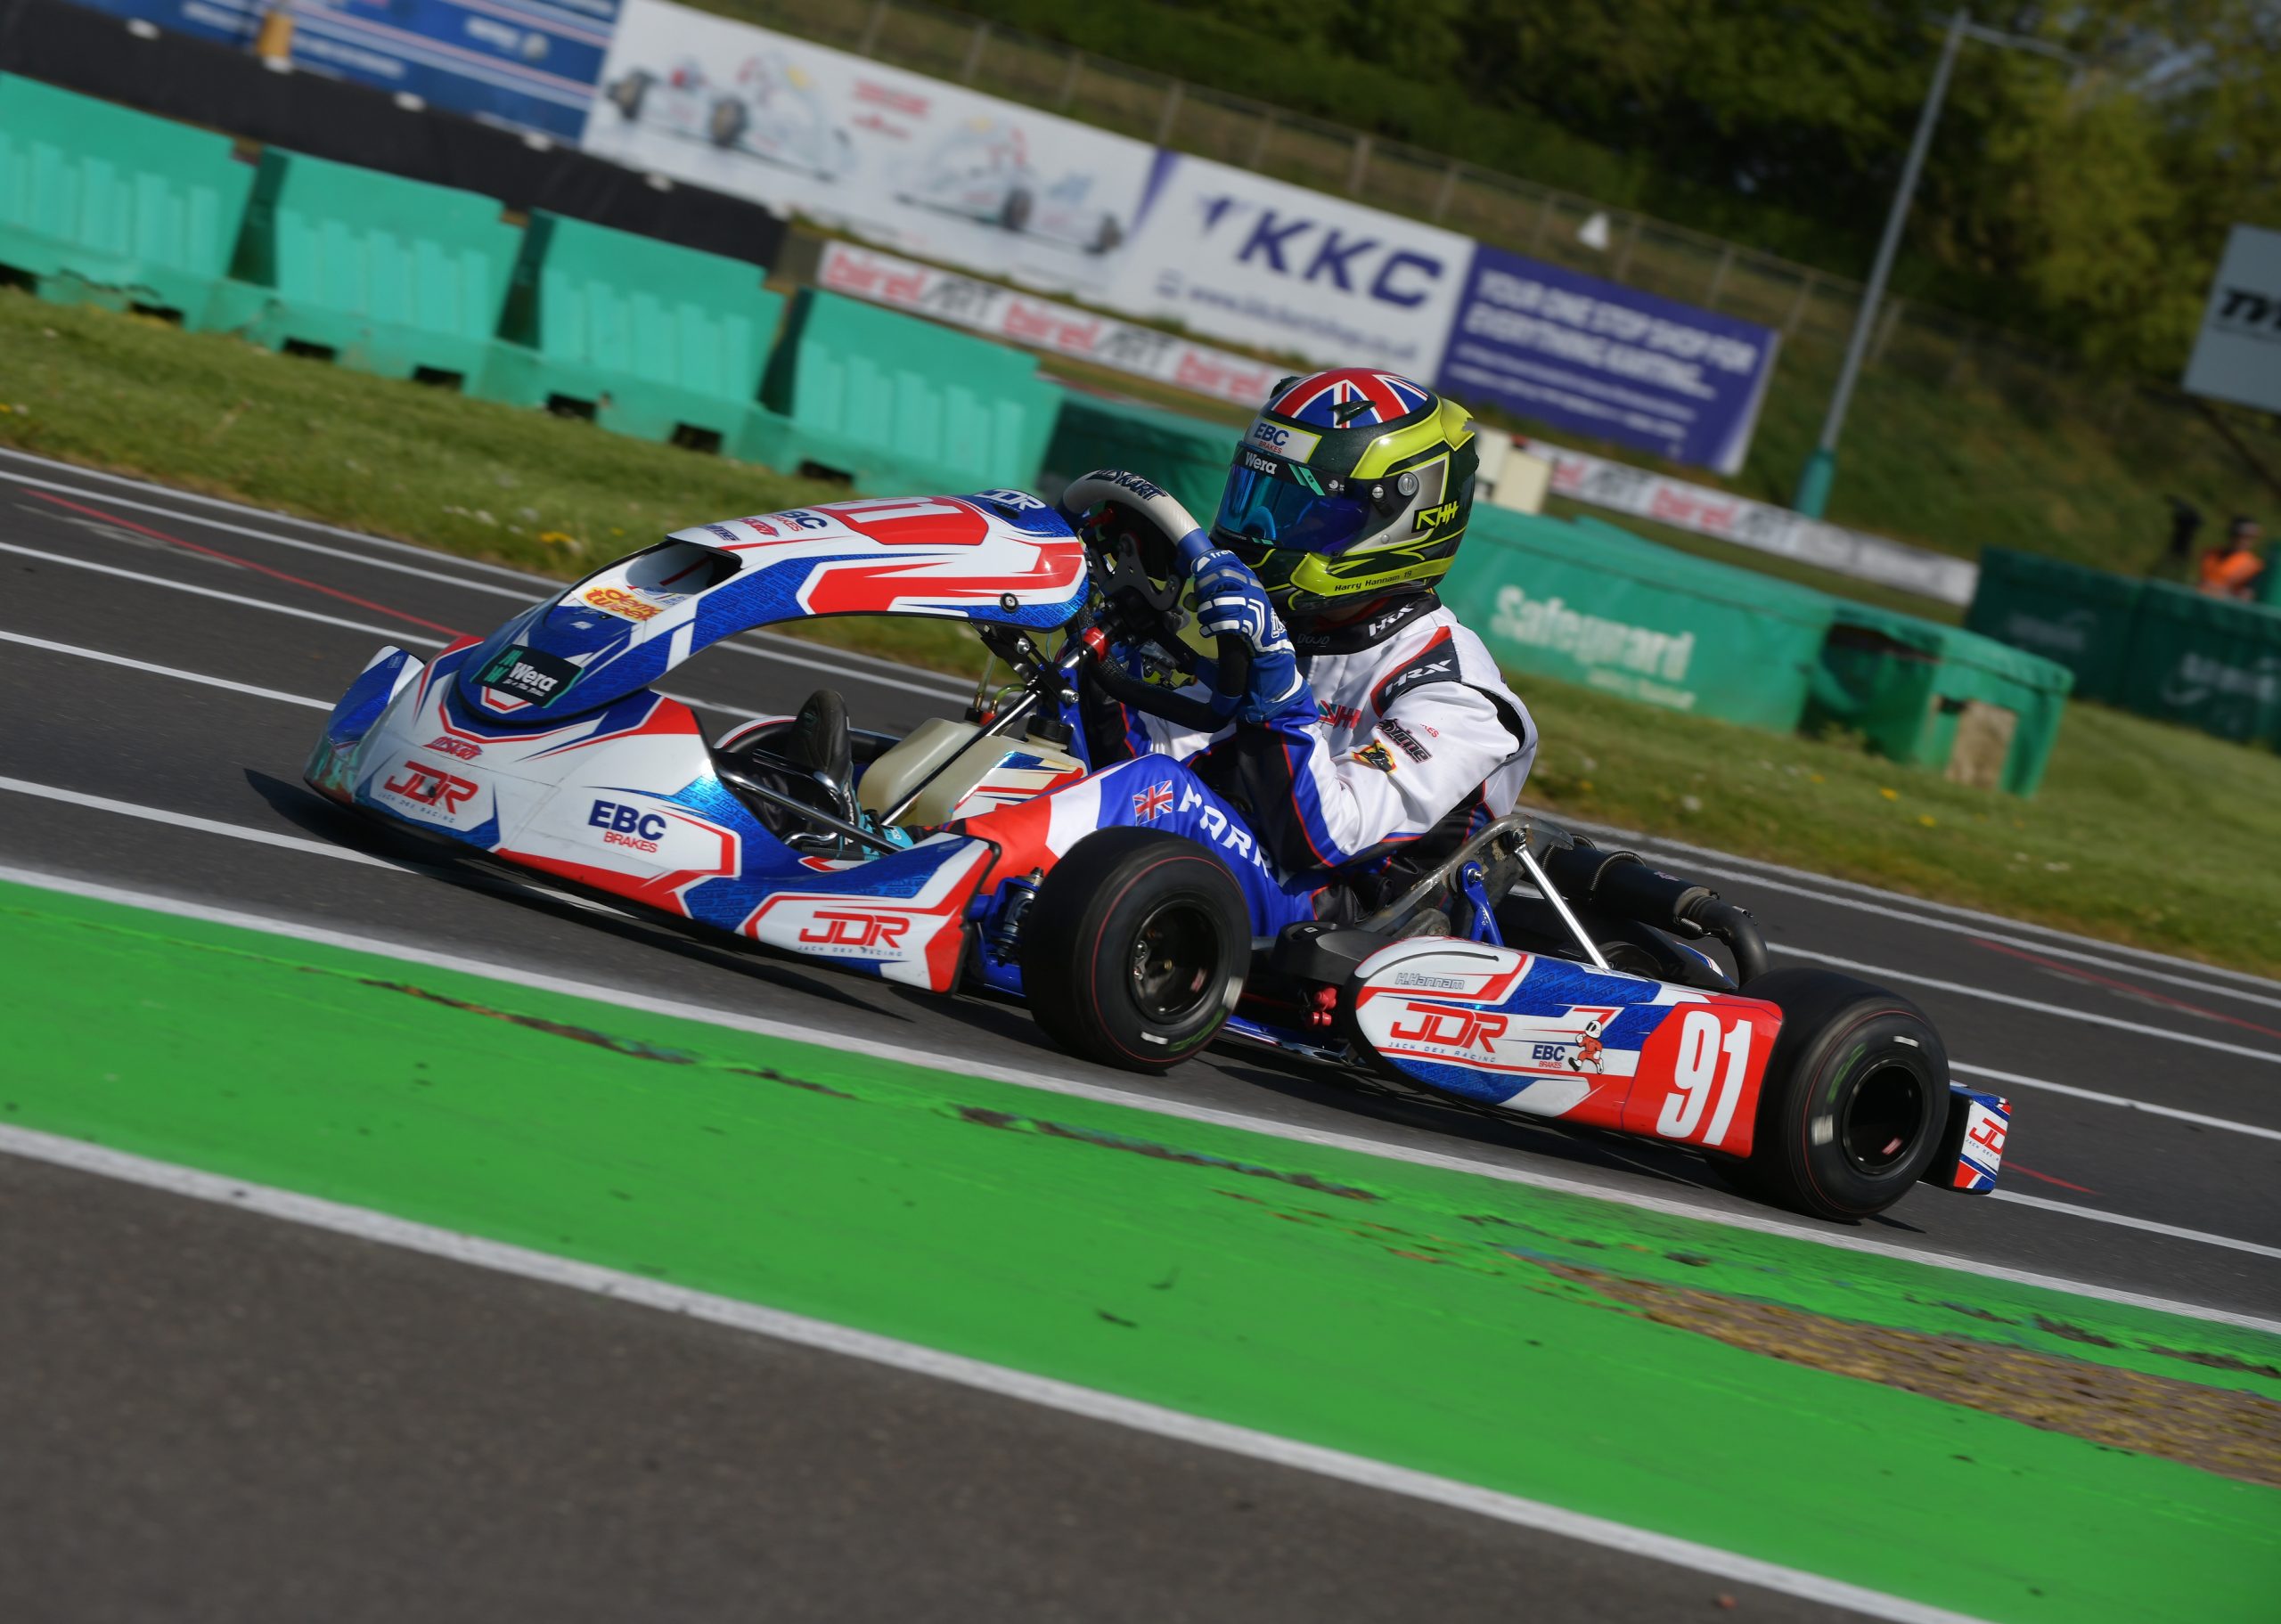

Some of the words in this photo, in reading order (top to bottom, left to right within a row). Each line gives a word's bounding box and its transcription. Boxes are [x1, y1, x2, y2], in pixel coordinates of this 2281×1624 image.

[1236, 208, 1443, 308] KKC
[1254, 422, 1290, 446] EBC
[1258, 440, 1284, 455] BRAKES
[1245, 451, 1279, 475] Wera
[777, 510, 828, 530] BC
[1334, 582, 1362, 592] Harry
[1364, 575, 1401, 587] Hannam
[508, 662, 560, 692] Wera
[383, 760, 479, 815] JDR
[588, 799, 667, 841] EBC
[603, 830, 658, 853] BRAKES
[798, 910, 911, 949] JDR
[1394, 972, 1466, 991] H.Hannam
[1390, 1001, 1509, 1054] JDR
[1532, 1044, 1566, 1062] EBC
[1538, 1060, 1563, 1069] BRAKES
[1656, 1009, 1754, 1147] 91
[1968, 1116, 2007, 1155] JD
